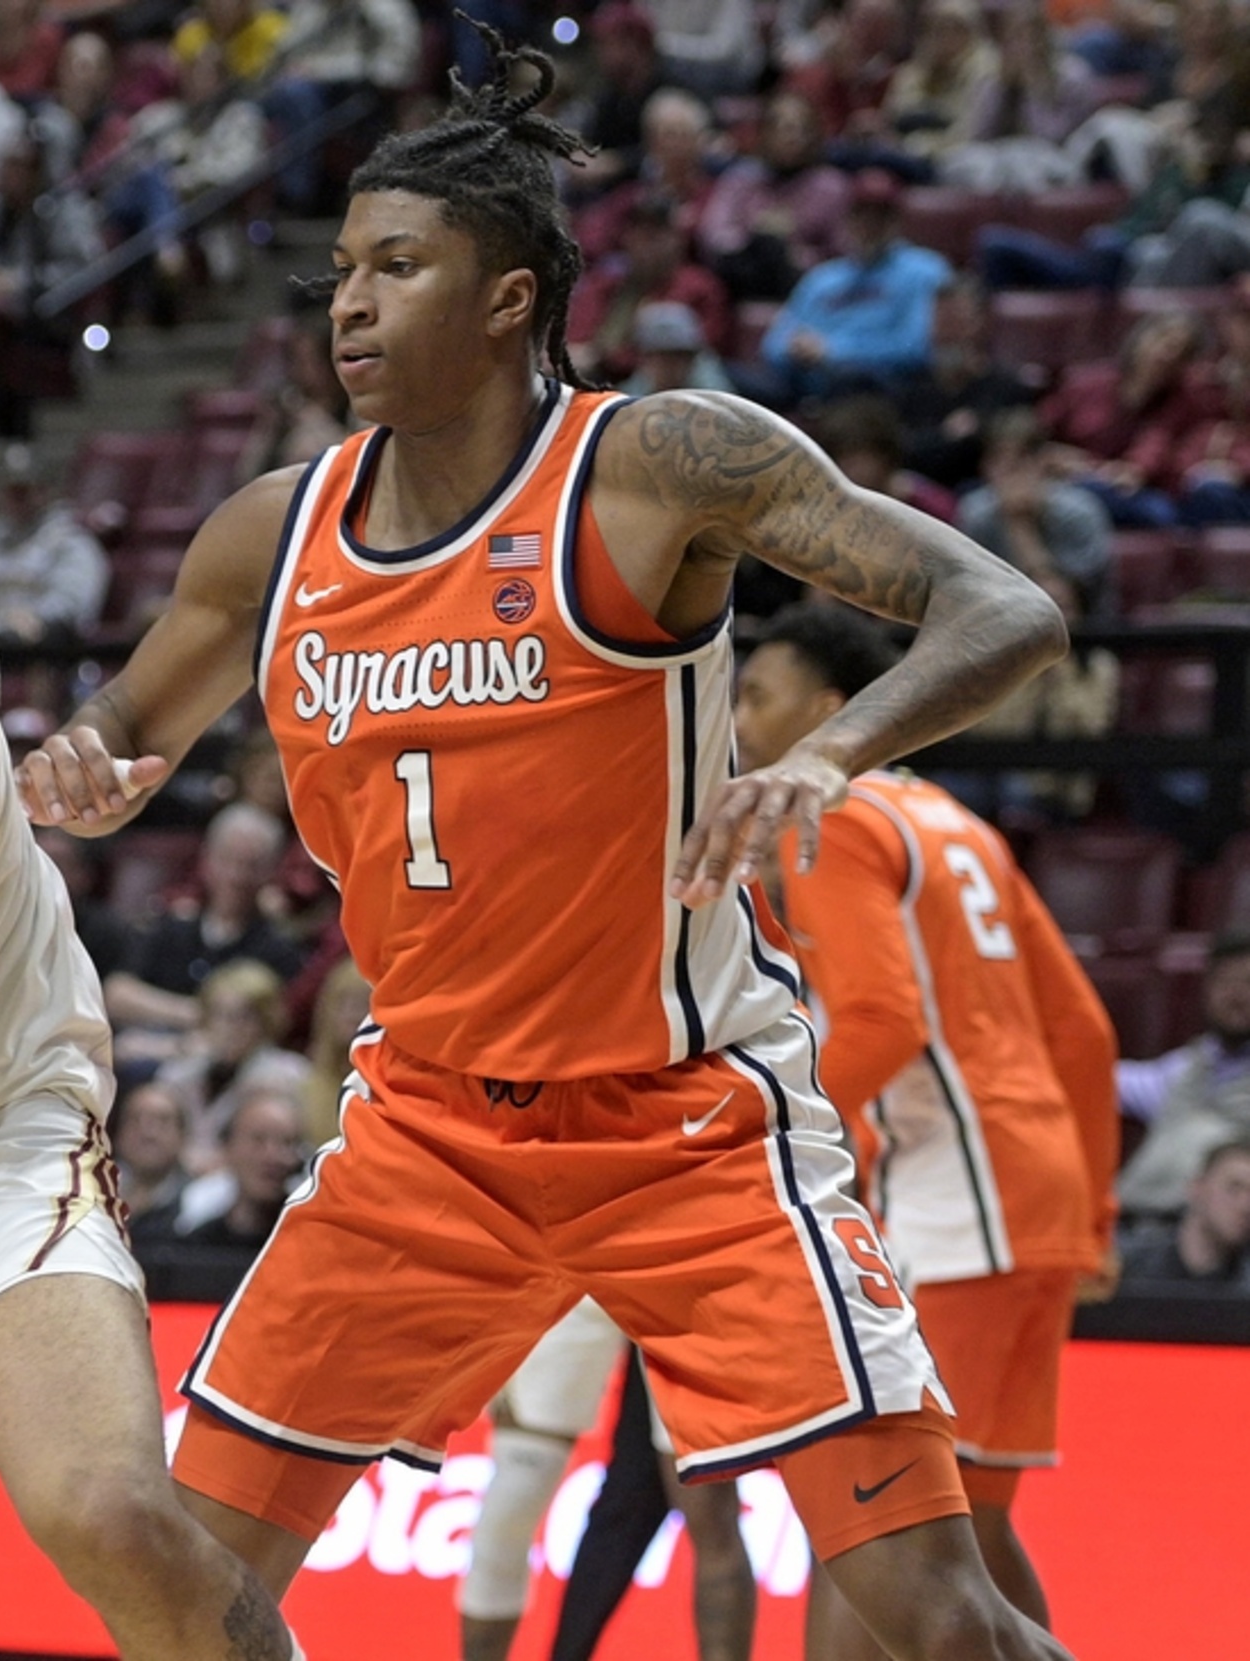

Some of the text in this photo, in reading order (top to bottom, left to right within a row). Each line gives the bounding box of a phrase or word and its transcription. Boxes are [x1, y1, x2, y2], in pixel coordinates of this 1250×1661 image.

[293, 629, 549, 746] Syracuse
[393, 750, 452, 889] 1
[942, 841, 1018, 960] 2
